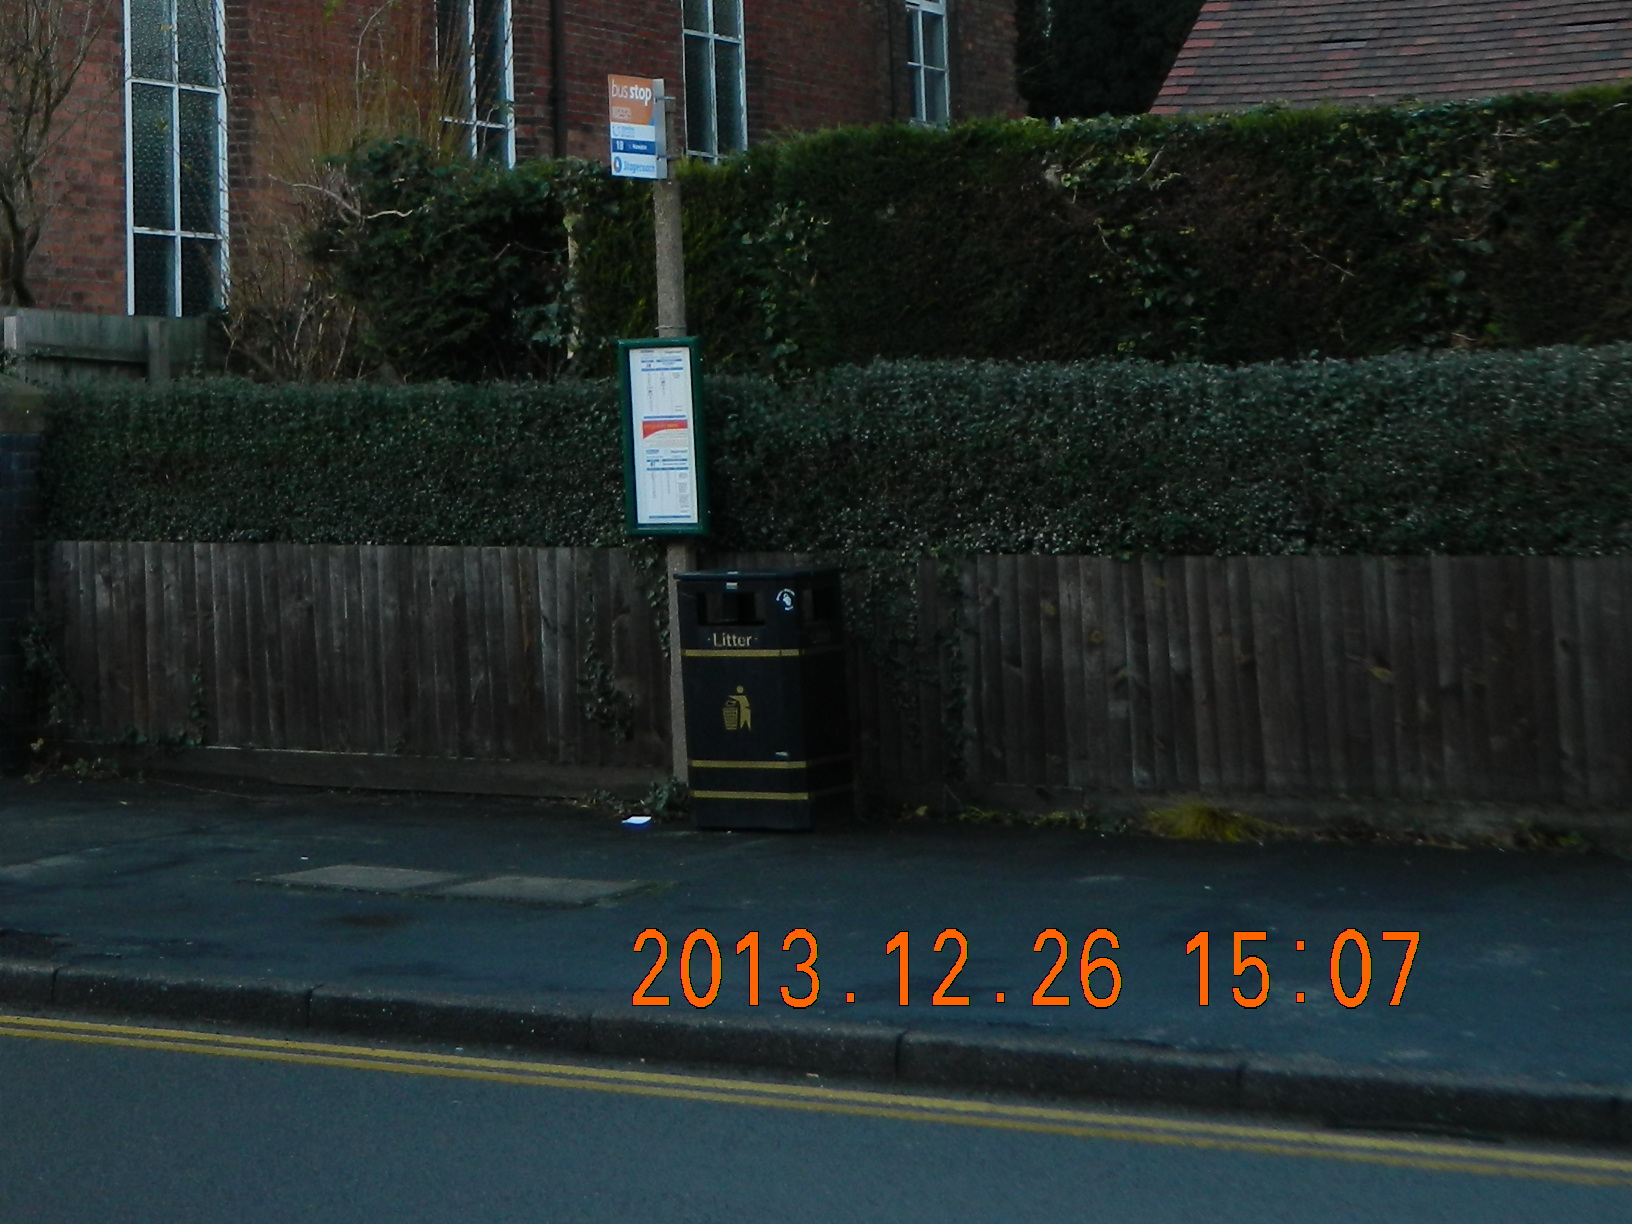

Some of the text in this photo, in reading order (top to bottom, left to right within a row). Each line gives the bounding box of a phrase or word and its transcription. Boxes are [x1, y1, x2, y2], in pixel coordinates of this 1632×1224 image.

[611, 79, 652, 107] bus stop
[713, 632, 752, 647] Litter
